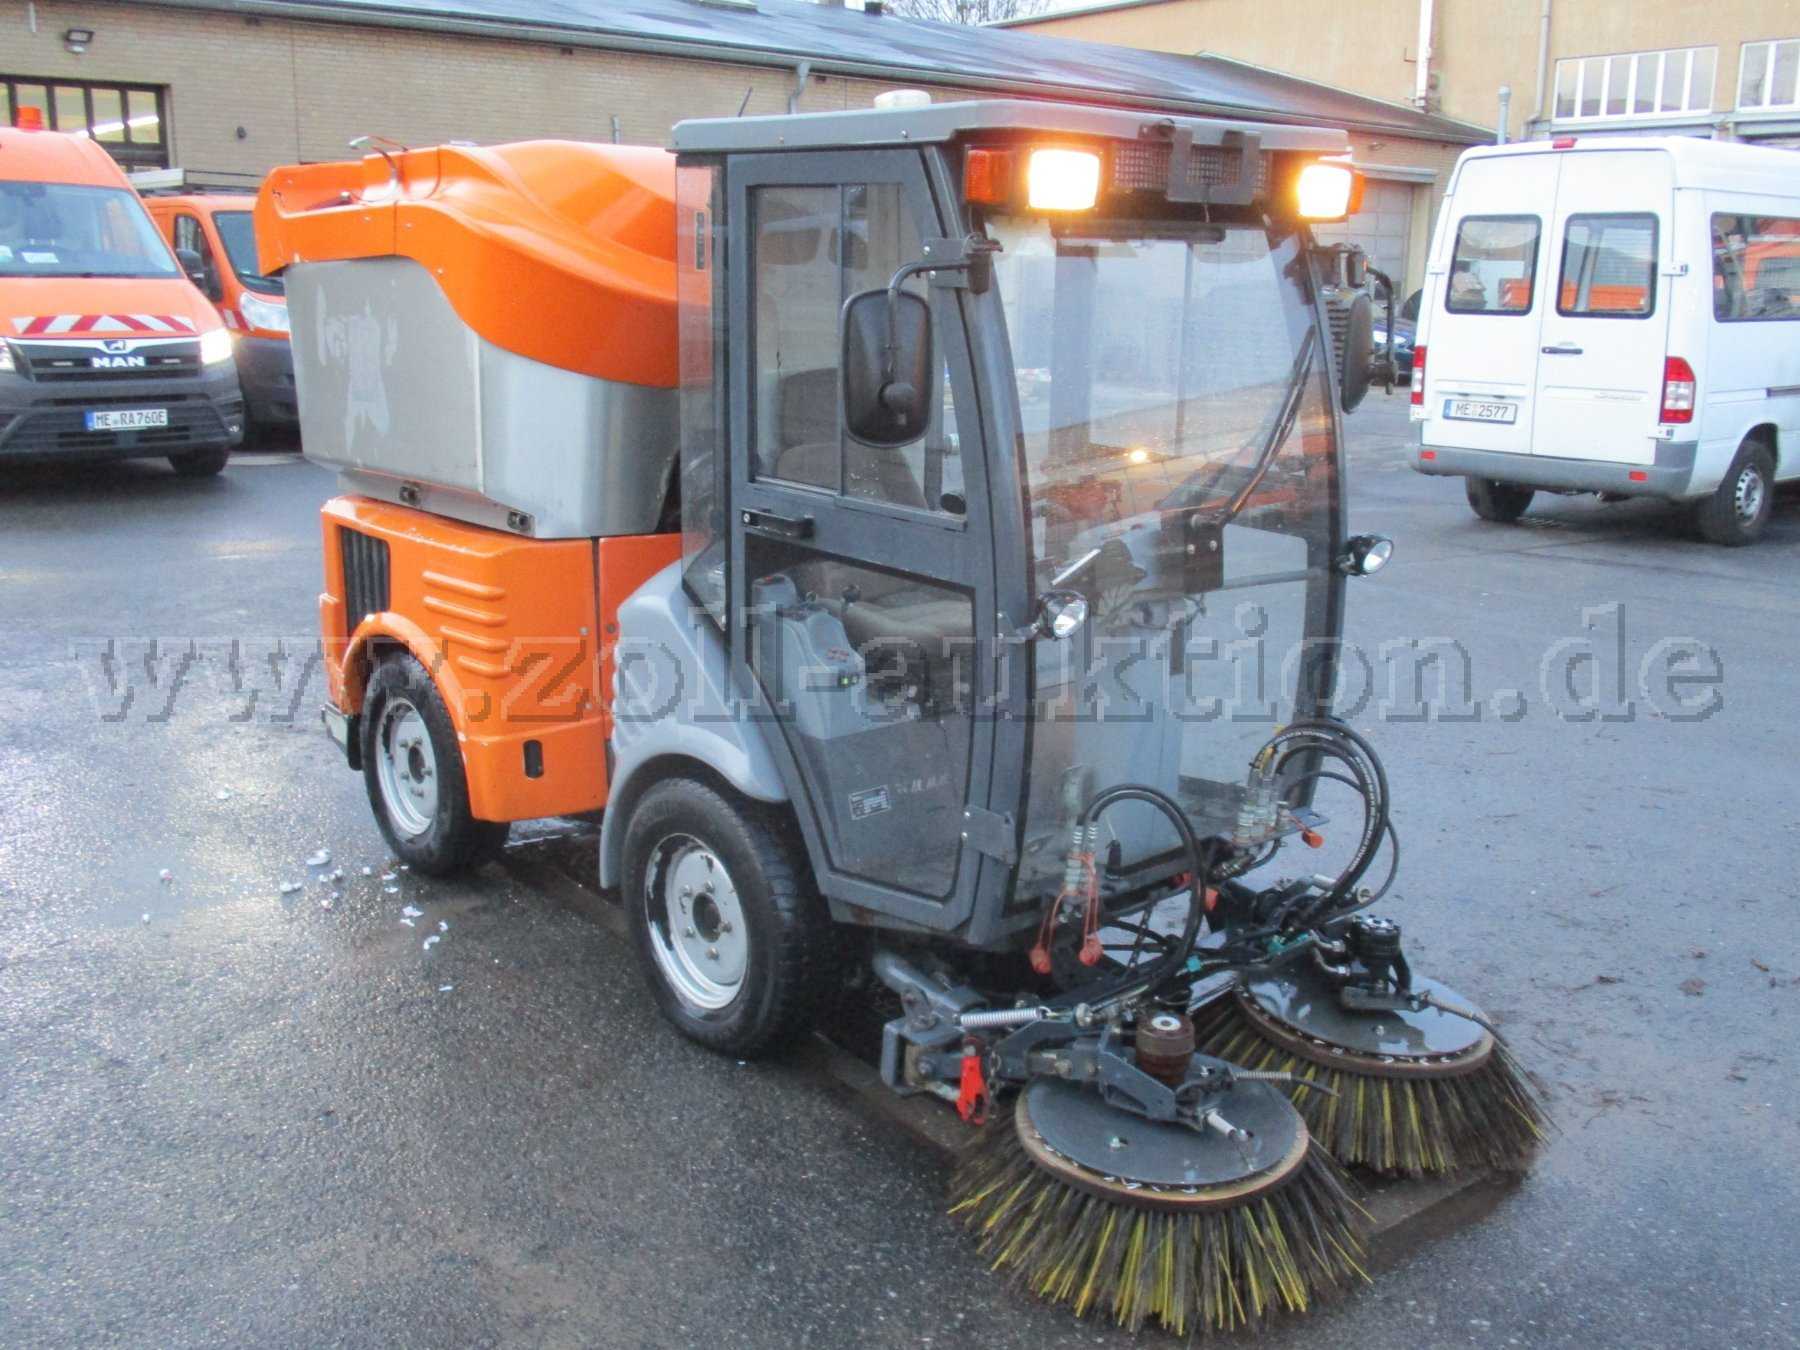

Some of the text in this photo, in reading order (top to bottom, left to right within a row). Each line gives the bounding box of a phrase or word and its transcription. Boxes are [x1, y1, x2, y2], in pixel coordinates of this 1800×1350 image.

[92, 356, 146, 368] MAN
[1456, 403, 1508, 419] ME 2577
[96, 413, 111, 427] ME
